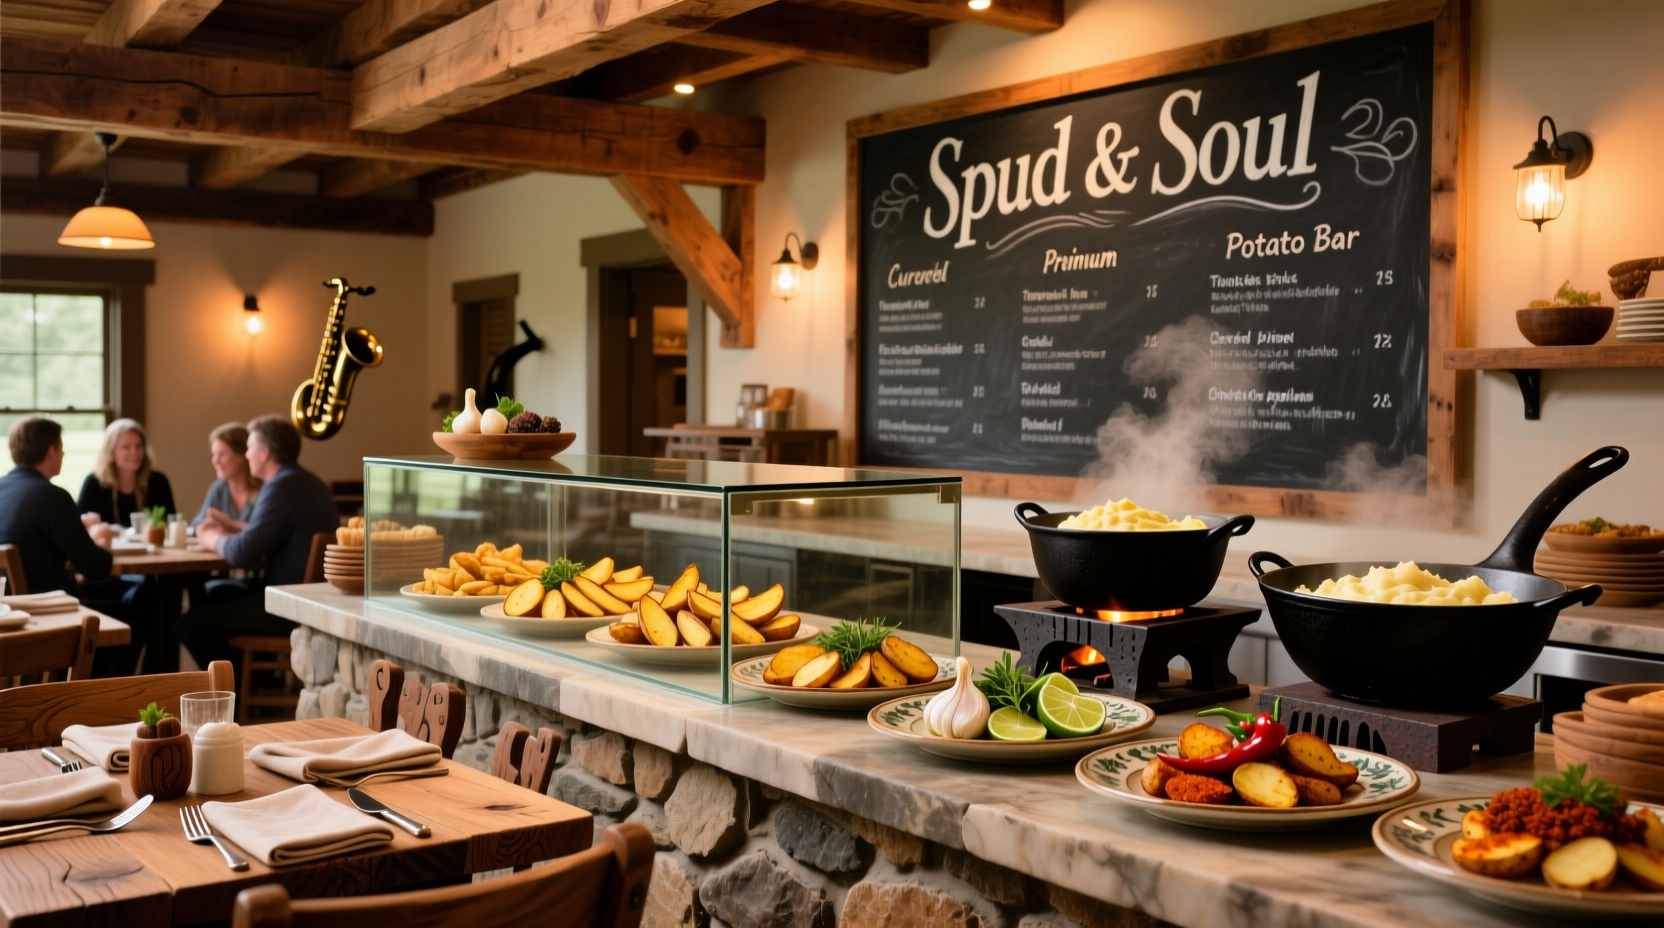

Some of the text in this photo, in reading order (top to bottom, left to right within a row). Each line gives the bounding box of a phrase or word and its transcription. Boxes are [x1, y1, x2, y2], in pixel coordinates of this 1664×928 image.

[923, 70, 1321, 249] Spud & Soul
[1226, 223, 1360, 260] Potato Bar
